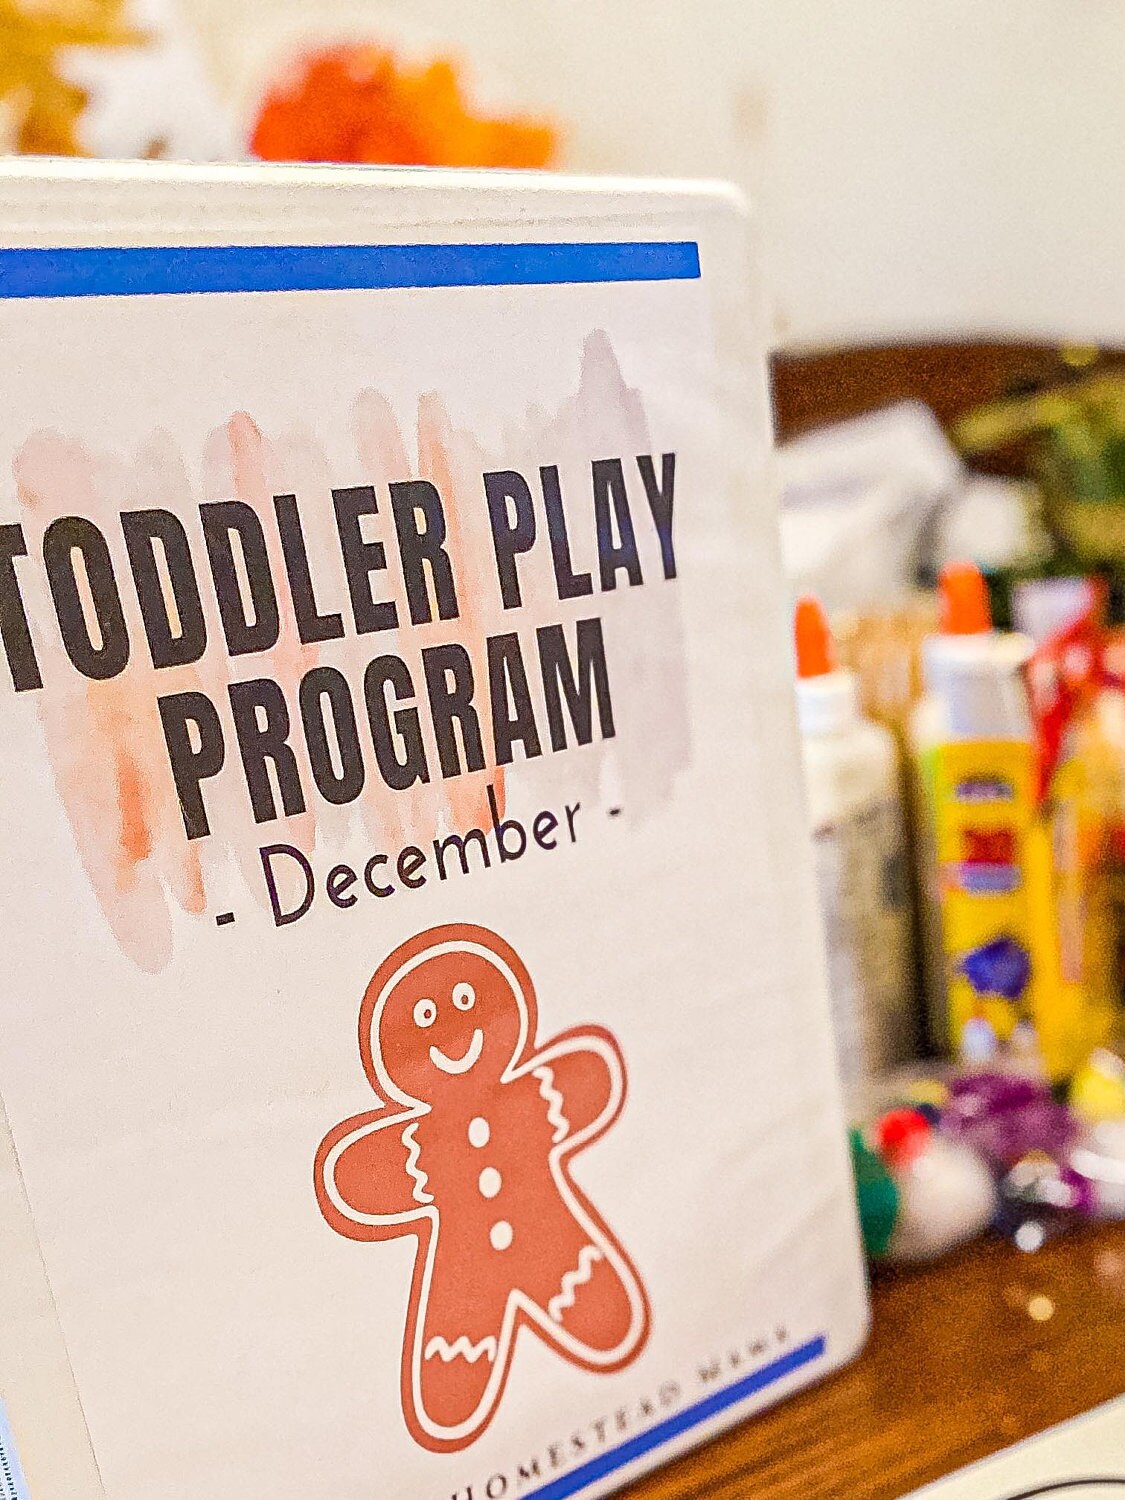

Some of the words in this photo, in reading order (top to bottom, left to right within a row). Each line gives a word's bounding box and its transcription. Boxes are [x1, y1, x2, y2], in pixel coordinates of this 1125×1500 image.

[0, 480, 458, 693] TODDLER
[483, 453, 678, 609] PLAY
[157, 616, 617, 841] PROGRAM
[259, 785, 583, 928] December
